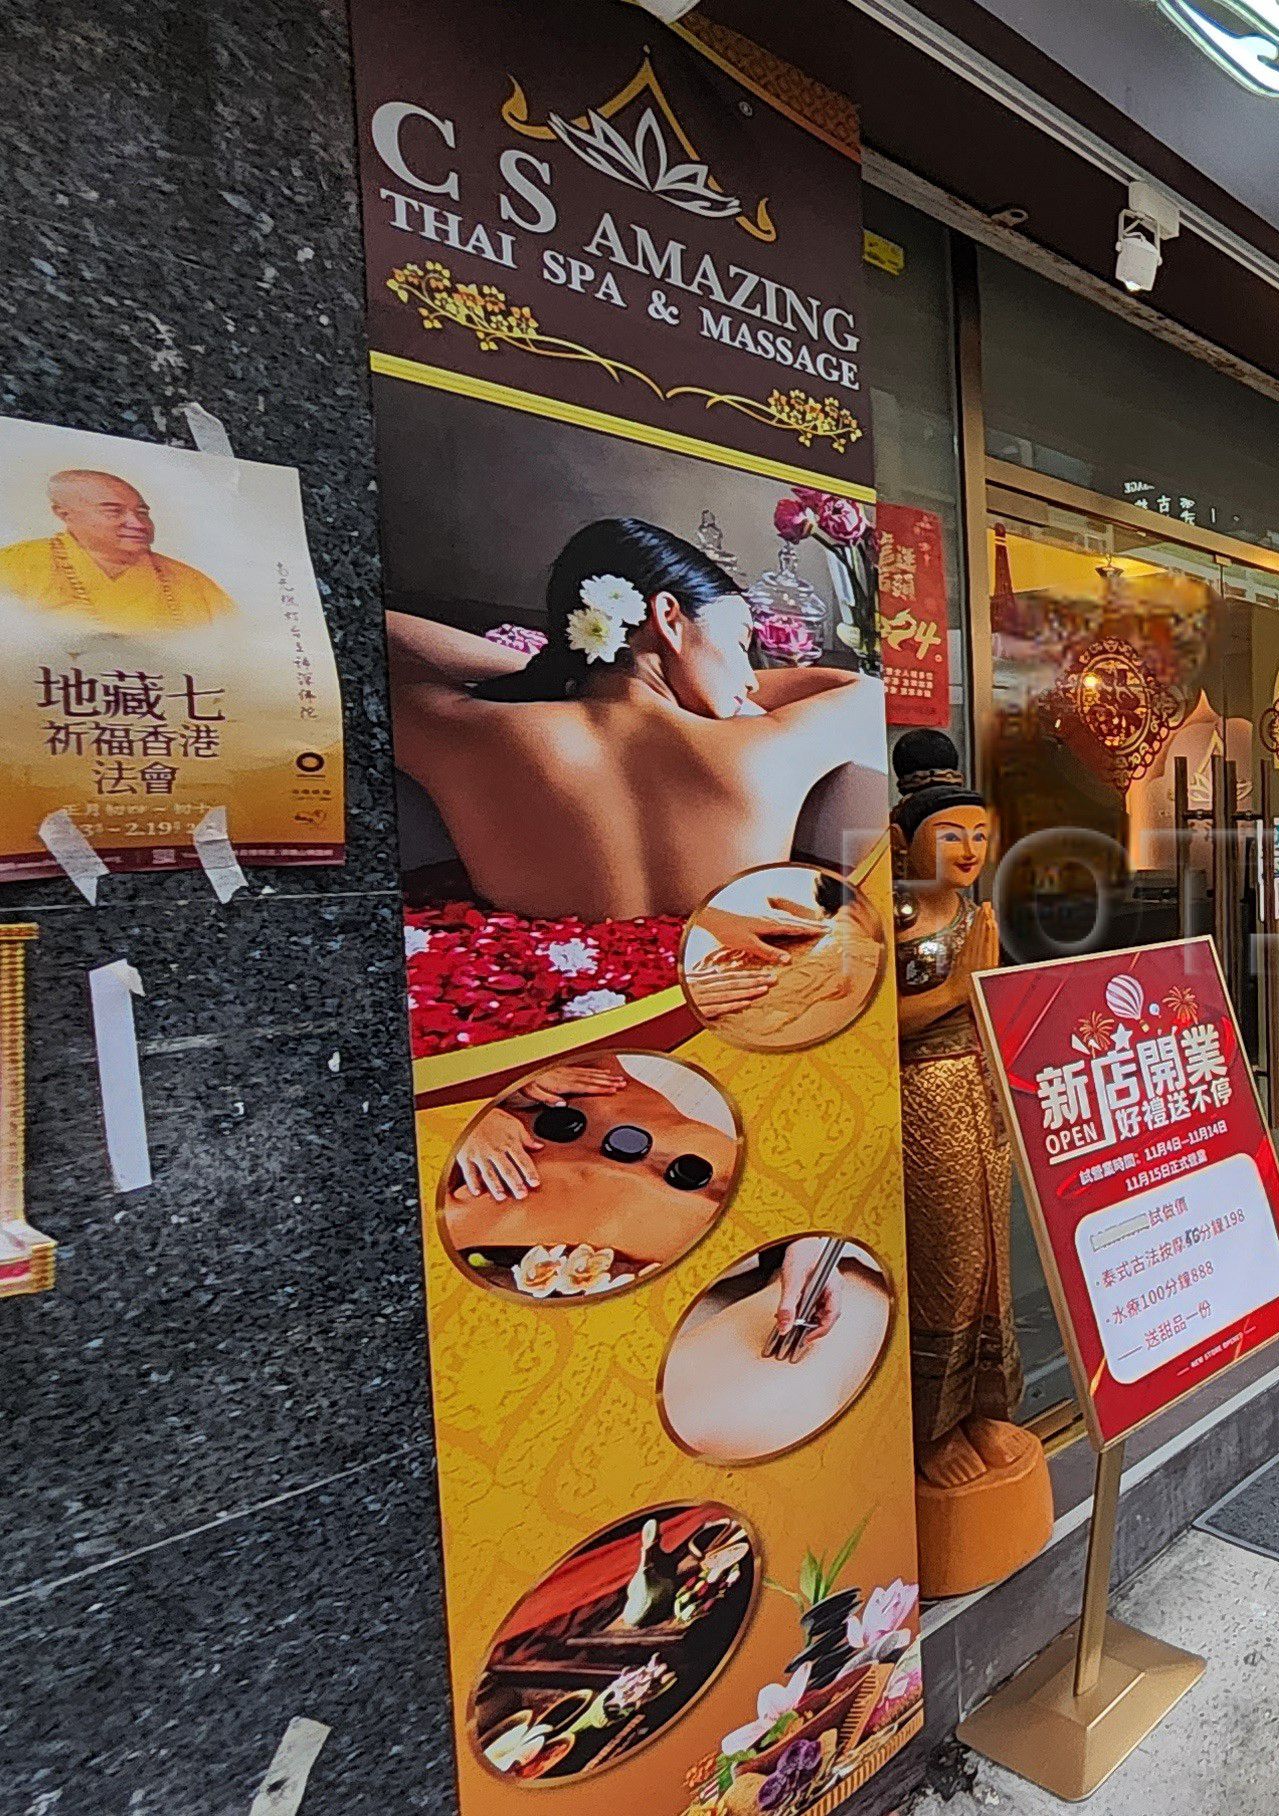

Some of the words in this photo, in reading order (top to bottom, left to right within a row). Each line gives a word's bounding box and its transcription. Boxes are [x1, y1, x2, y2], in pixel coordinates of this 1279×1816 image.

[371, 102, 459, 201] C
[500, 149, 557, 234] S
[583, 213, 861, 353] AMAZING
[379, 188, 518, 269] THAI
[542, 250, 628, 308] SPA
[647, 290, 681, 326] &
[699, 306, 861, 391] MASSAGE
[34, 664, 227, 724] 地藏七
[43, 720, 221, 760] 祈福香港
[91, 760, 179, 797] 法會
[1036, 1024, 1229, 1131] 新店開業
[1045, 1121, 1099, 1155] OPEN
[1115, 1077, 1233, 1141] 好禮送不停
